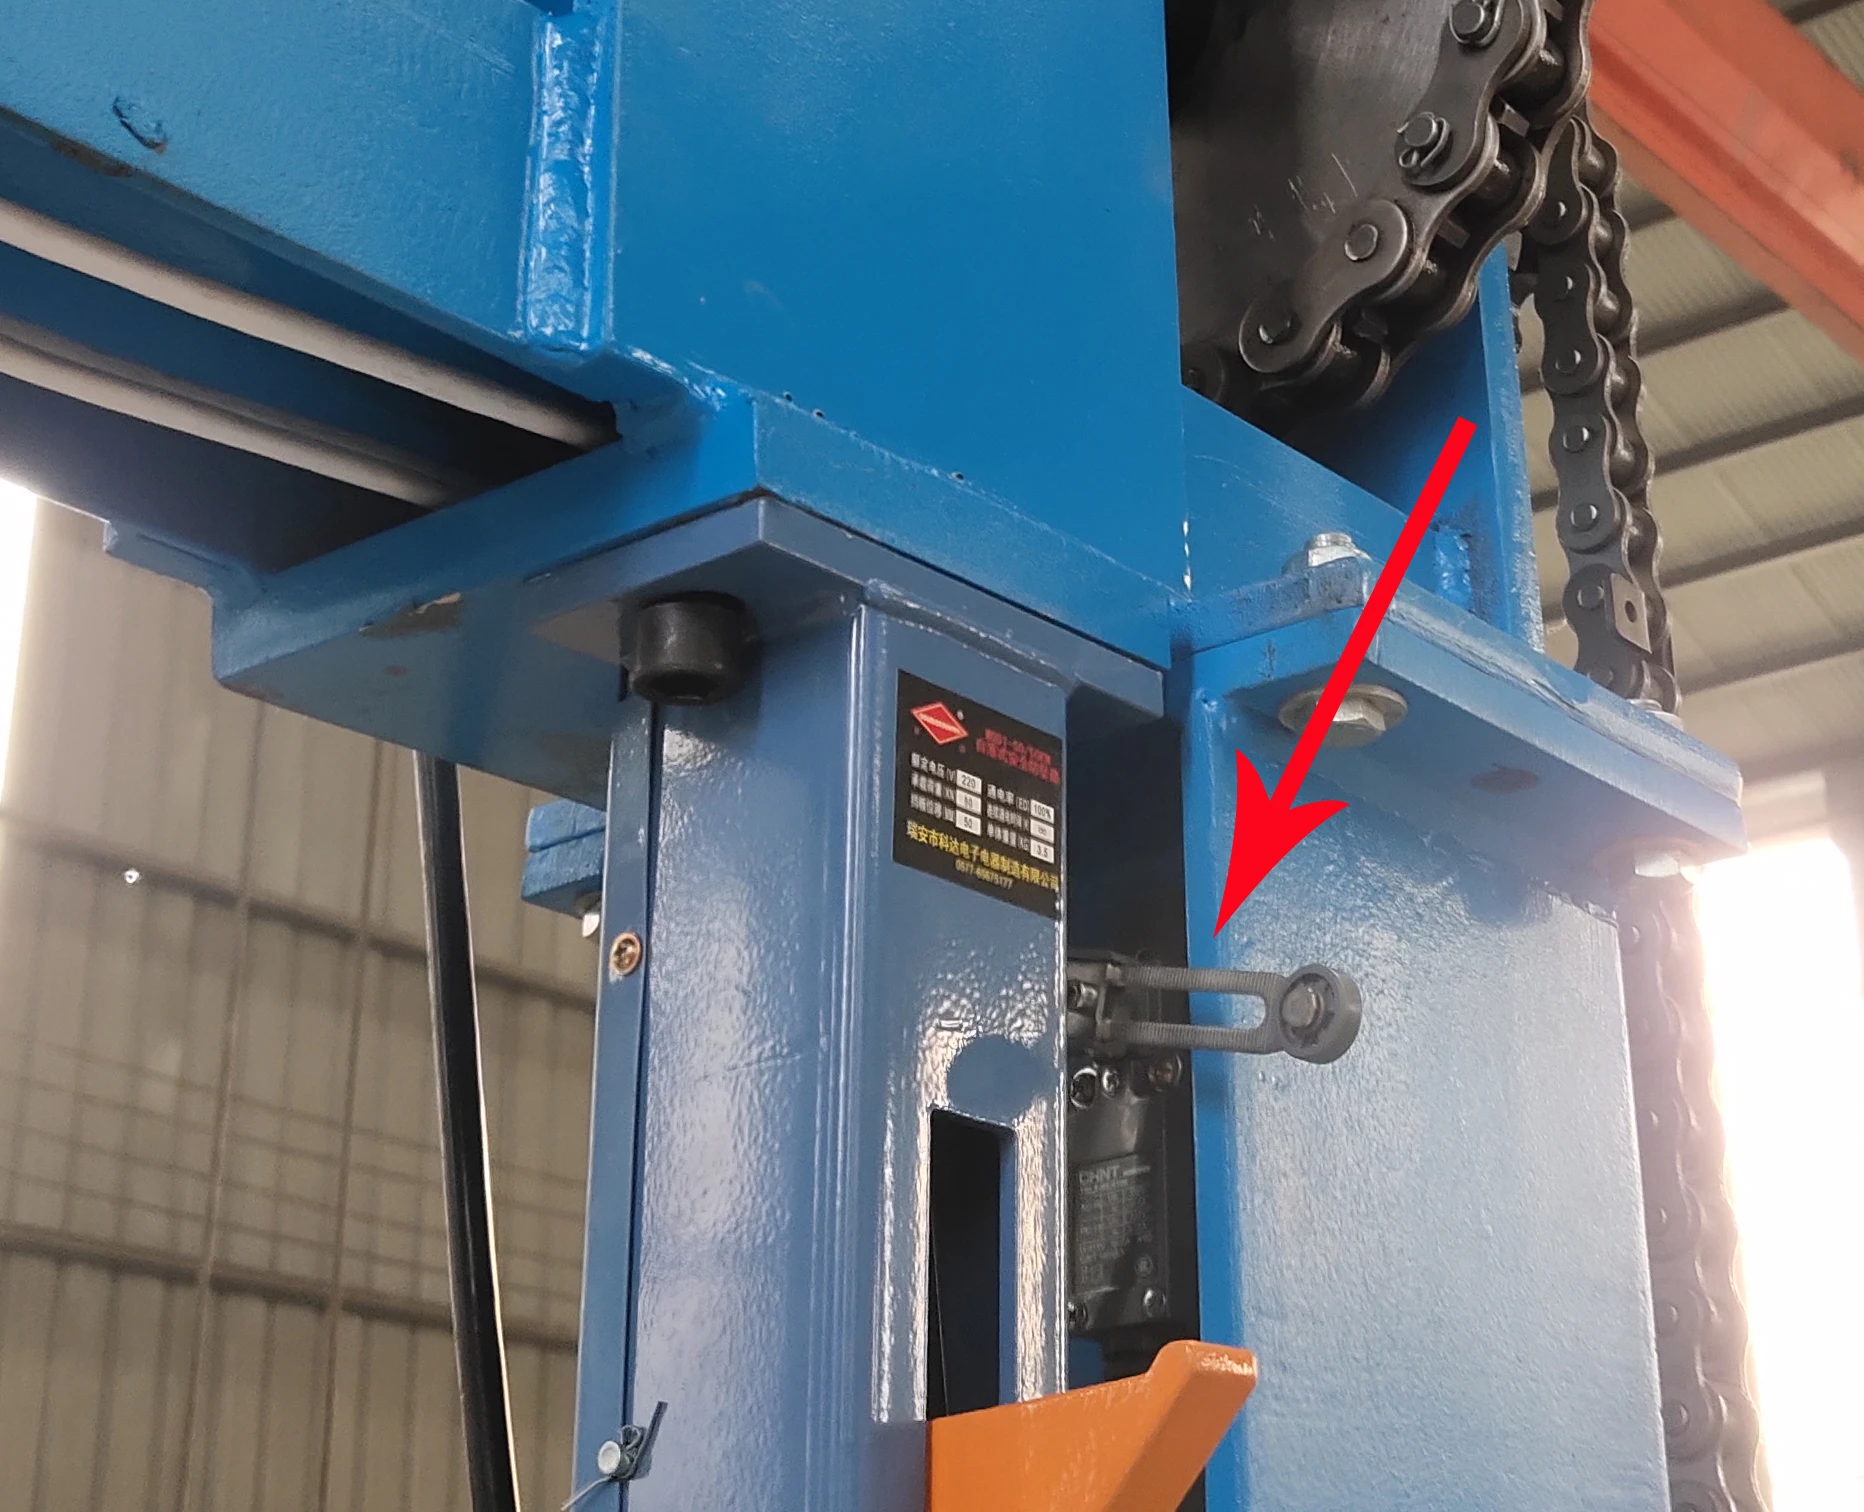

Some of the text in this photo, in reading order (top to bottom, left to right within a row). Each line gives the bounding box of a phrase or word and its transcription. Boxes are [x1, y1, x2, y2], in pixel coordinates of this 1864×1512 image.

[961, 774, 976, 789] 220
[1034, 805, 1052, 820] 100%
[963, 816, 973, 829] 50
[1036, 844, 1048, 858] 3.5
